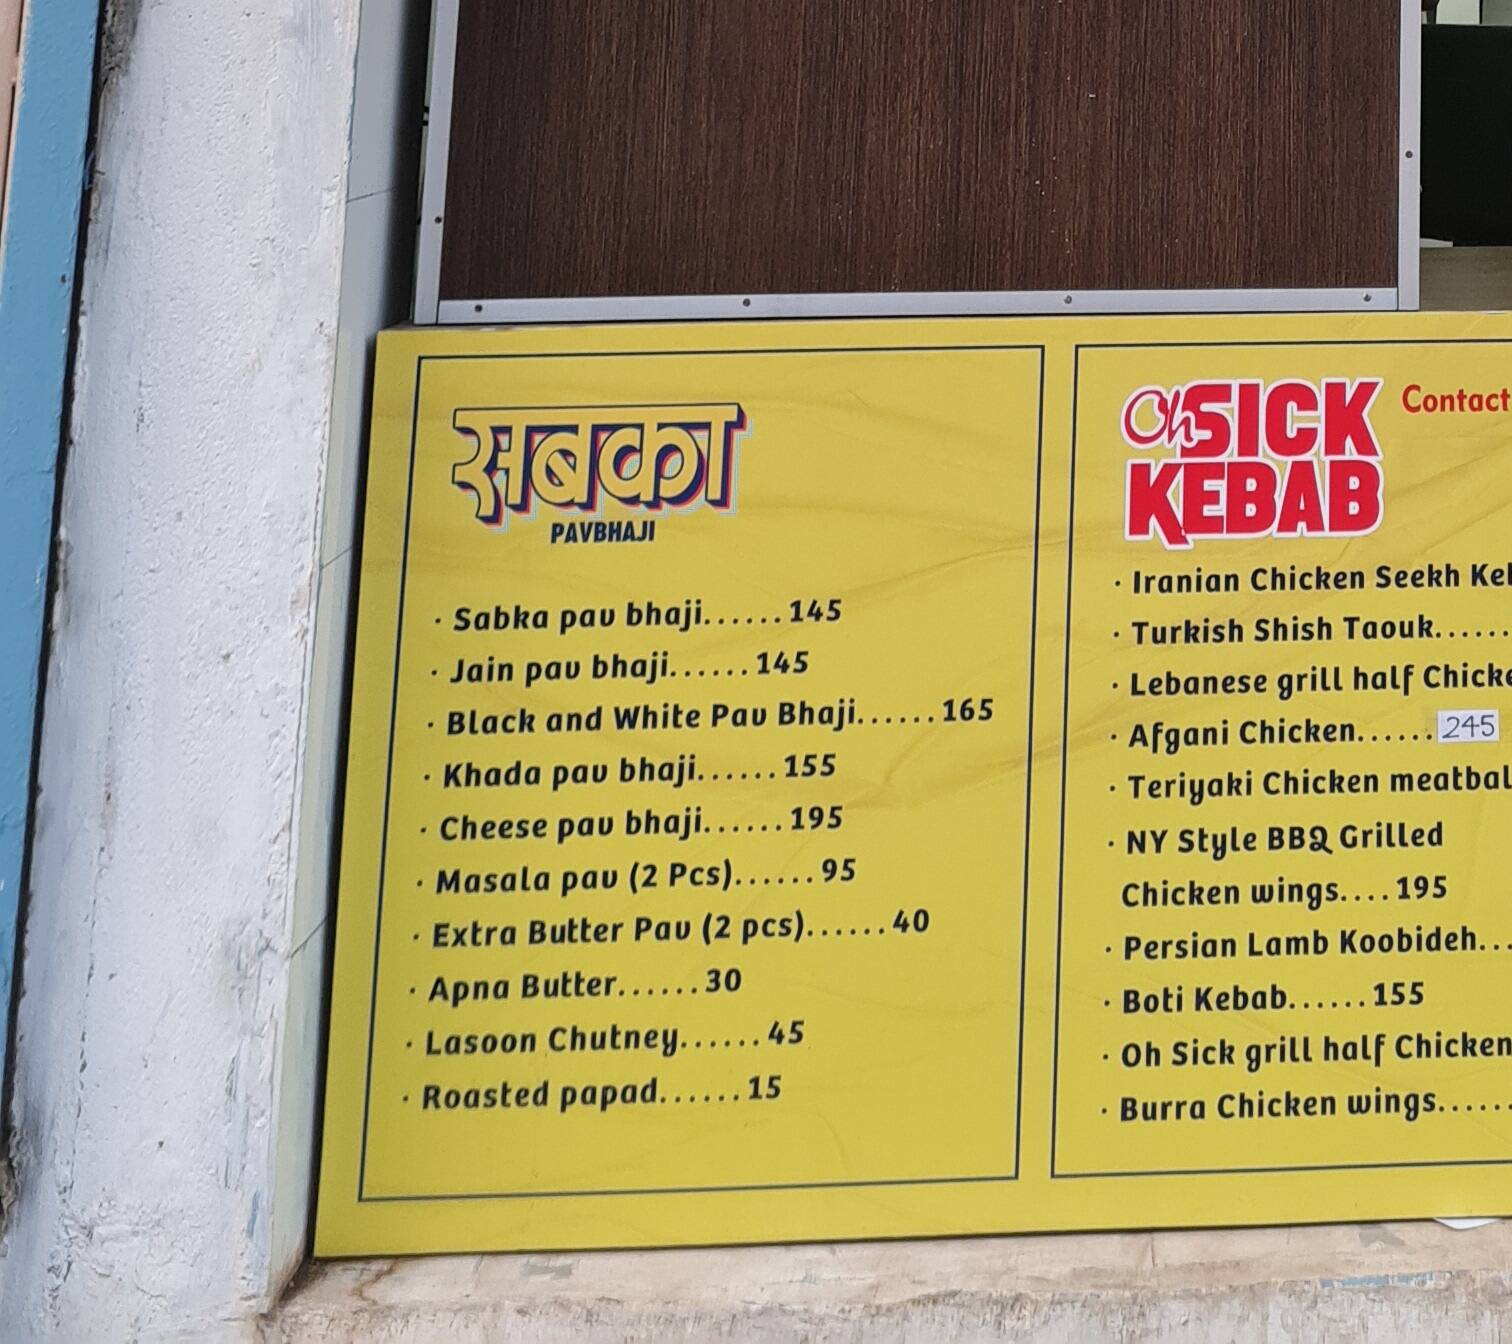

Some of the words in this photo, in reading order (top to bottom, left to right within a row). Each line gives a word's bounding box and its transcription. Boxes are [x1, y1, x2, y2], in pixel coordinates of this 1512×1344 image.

[1401, 383, 1512, 415] Contact
[1179, 379, 1382, 459] SICK
[451, 402, 752, 532] सबका
[1126, 460, 1382, 546] KEBAB
[550, 520, 656, 544] PAVBHAJI
[1133, 566, 1239, 594] Iranian
[1250, 564, 1365, 592] Chicken
[1375, 563, 1460, 589] Seekh
[453, 604, 549, 632] Sabka
[1131, 617, 1244, 645] Turkish
[1254, 615, 1332, 642] Shish
[1130, 670, 1268, 696] Lebanese
[1277, 665, 1343, 701] grill
[1353, 664, 1415, 697] half
[447, 707, 536, 736] Black
[546, 705, 603, 733] and
[613, 702, 701, 730] White
[1442, 714, 1495, 739] 245
[1128, 719, 1229, 756] Afgani
[1127, 769, 1252, 806] Teriyaki
[1262, 768, 1379, 796] Chicken
[1127, 829, 1168, 855] NY
[1177, 826, 1257, 862] Style
[1268, 825, 1333, 854] BBQ
[1339, 822, 1443, 850] Grilled
[435, 866, 550, 895] Masala
[629, 861, 658, 895] (2
[1121, 879, 1240, 908] Chicken
[432, 920, 517, 948] Extra
[528, 917, 624, 945] Butter
[702, 912, 731, 946] (2
[1124, 931, 1237, 961] Persian
[1248, 929, 1329, 957] Lamb
[428, 976, 510, 1009] Apna
[1123, 985, 1183, 1014] Boti
[426, 1030, 537, 1056] Lasoon
[1121, 1041, 1161, 1068] Oh
[1171, 1038, 1235, 1066] Sick
[1245, 1035, 1313, 1073] grill
[1323, 1033, 1386, 1068] half
[422, 1080, 549, 1110] Roasted
[1120, 1097, 1206, 1122] Burra
[1217, 1090, 1336, 1119] Chicken
